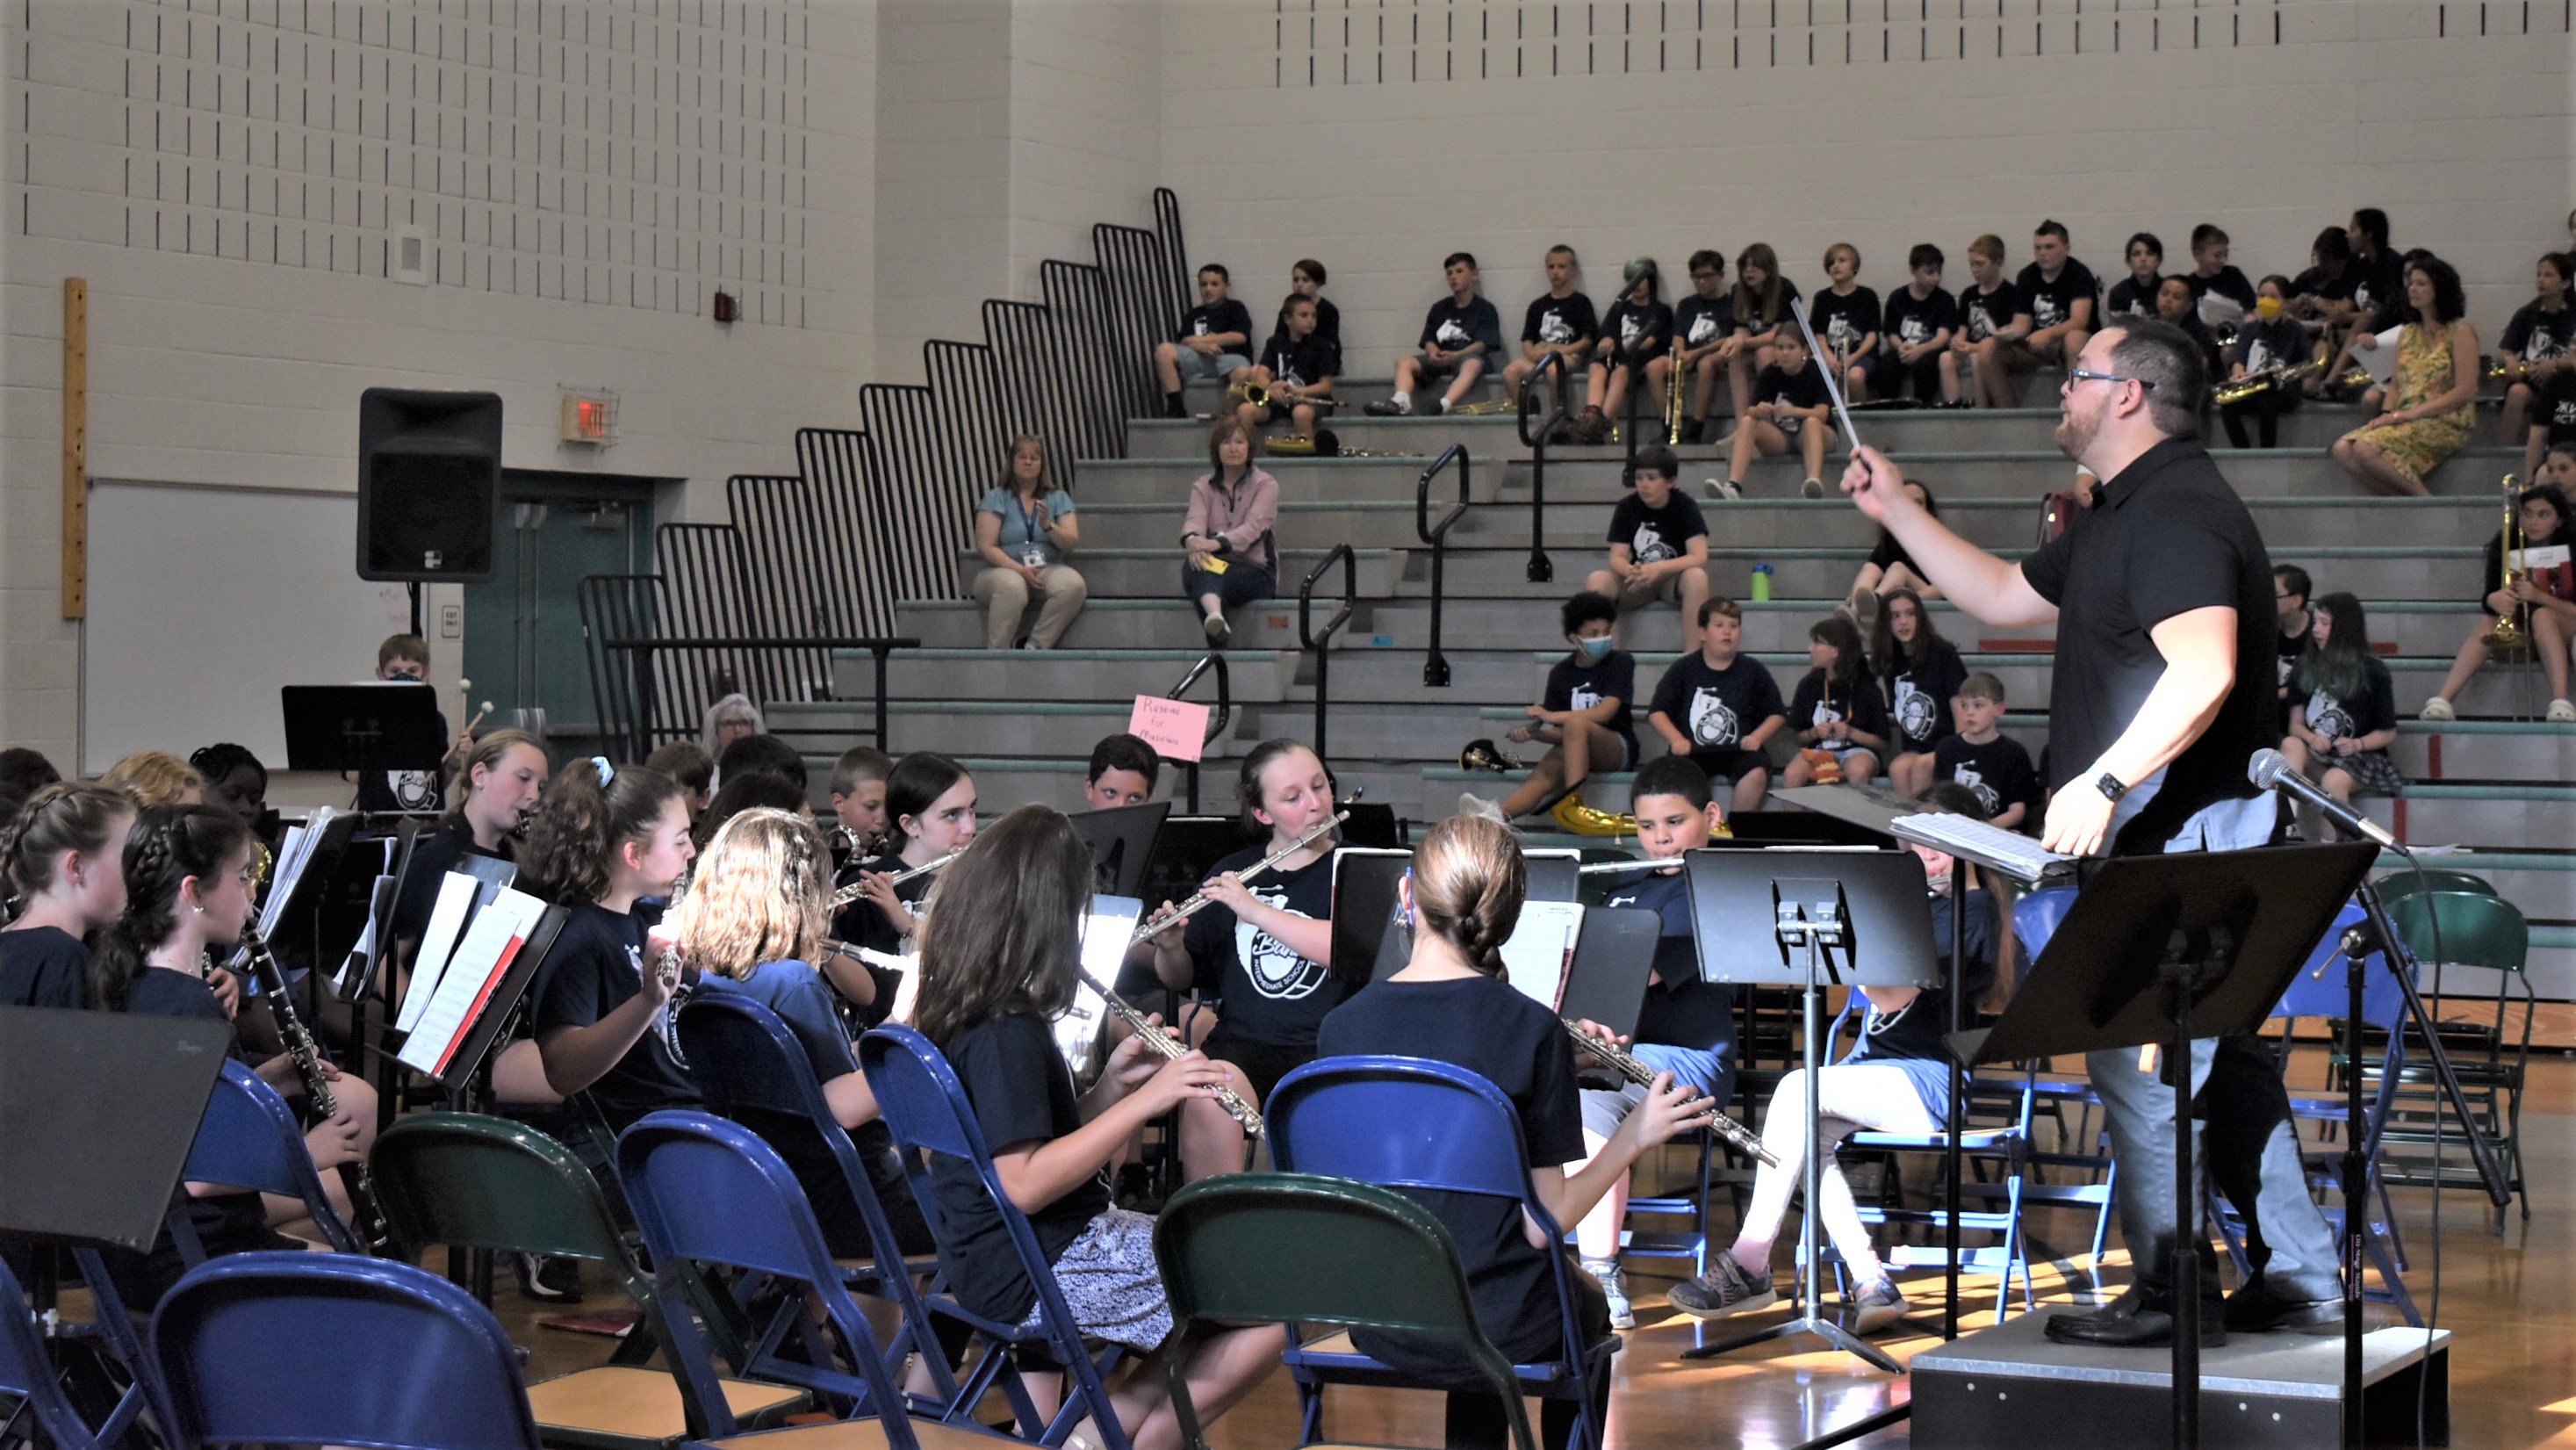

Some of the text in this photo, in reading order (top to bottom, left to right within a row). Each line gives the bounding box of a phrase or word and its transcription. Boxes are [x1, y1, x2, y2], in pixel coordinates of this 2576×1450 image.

[1150, 715, 1165, 728] for
[1254, 958, 1306, 991] INTERMEDIATE SCHOOL
